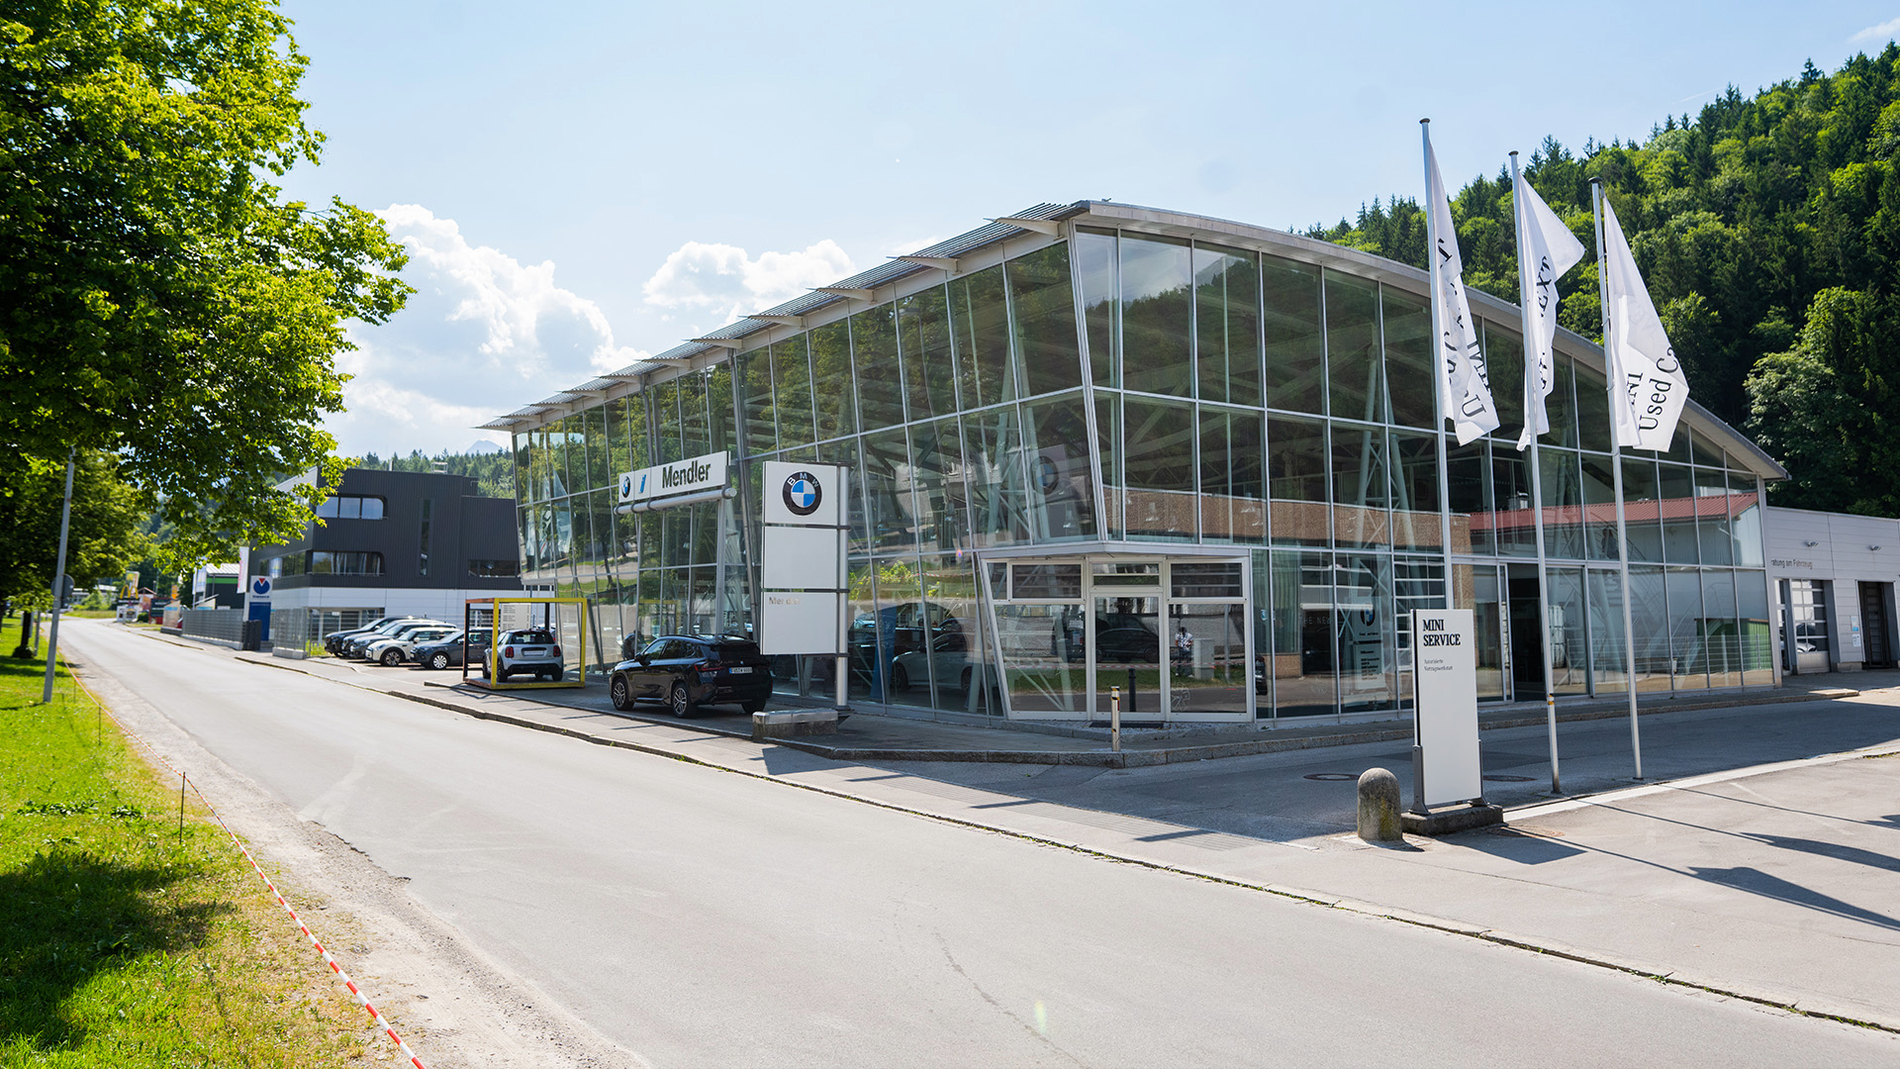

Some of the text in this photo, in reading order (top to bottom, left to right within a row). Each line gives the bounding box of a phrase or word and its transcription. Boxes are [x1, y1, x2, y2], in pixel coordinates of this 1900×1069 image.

[1638, 378, 1672, 431] Used
[661, 460, 712, 489] Mendler
[1423, 619, 1445, 631] MINI
[1423, 633, 1461, 647] SERVICE
